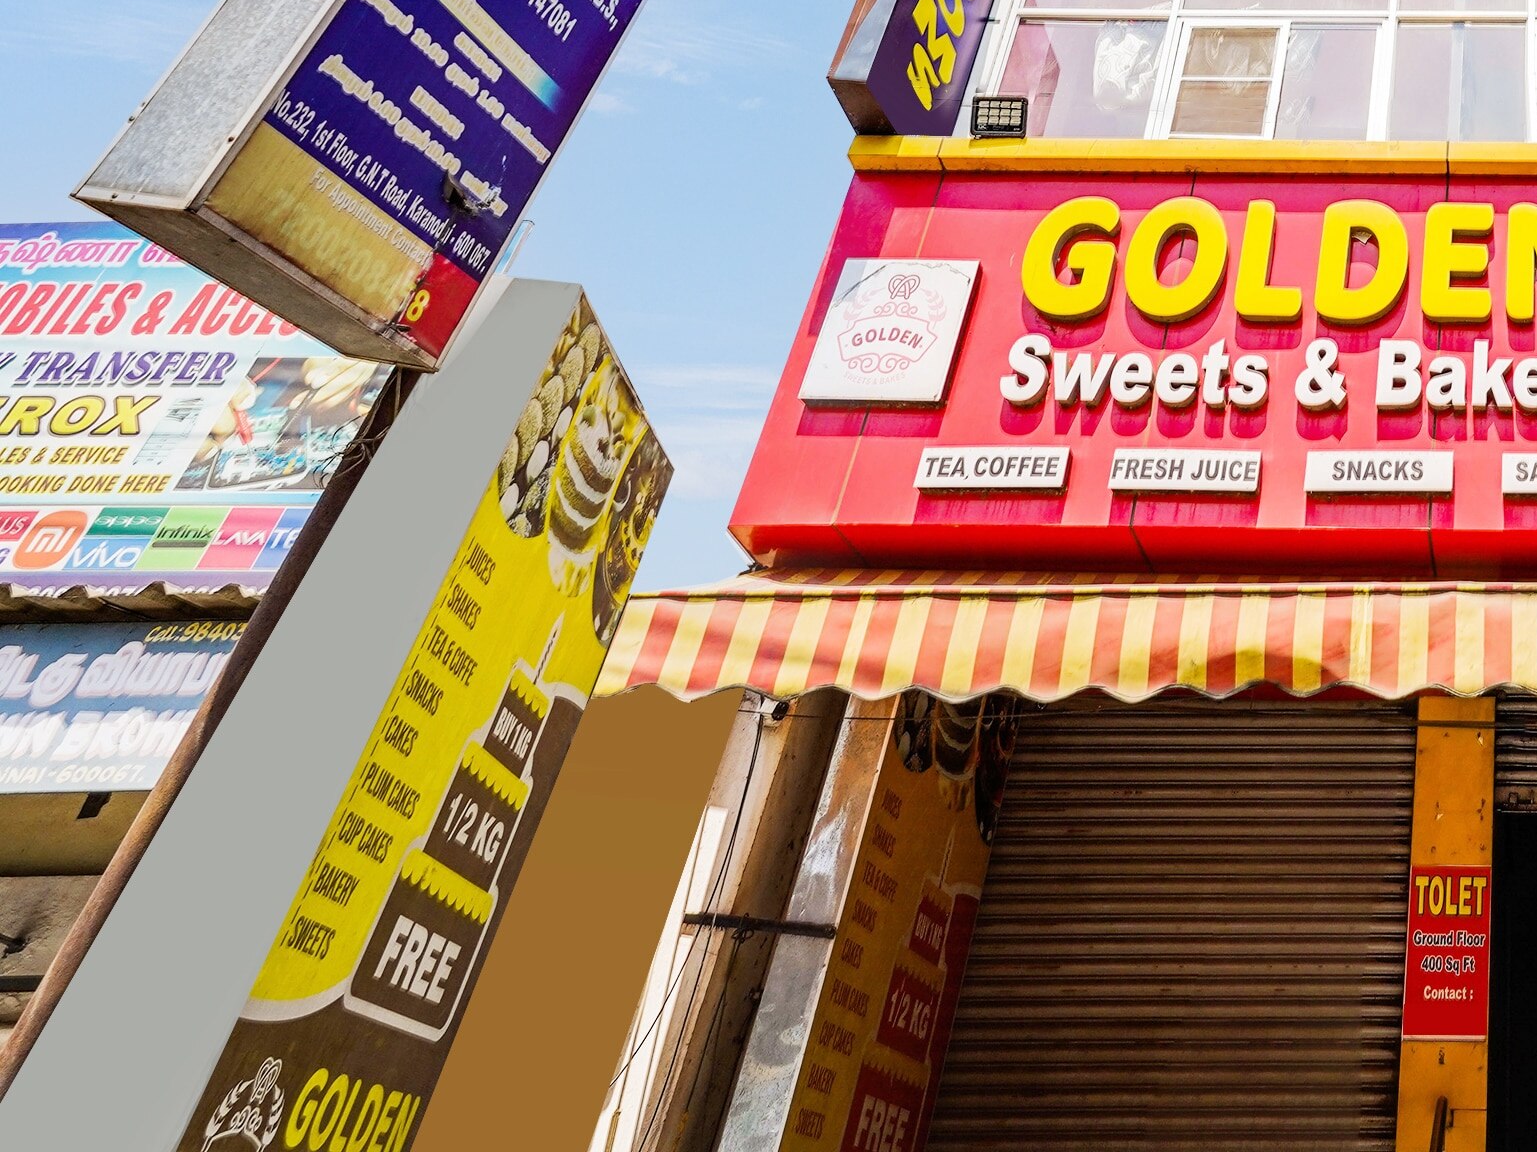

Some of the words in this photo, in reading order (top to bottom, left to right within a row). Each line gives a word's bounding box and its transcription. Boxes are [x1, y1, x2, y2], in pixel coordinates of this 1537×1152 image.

[311, 120, 335, 156] 1st
[329, 132, 360, 177] Floor,
[355, 154, 390, 192] G.N.T
[381, 173, 411, 218] Road,
[406, 195, 451, 245] Karanodi
[453, 231, 475, 259] 600
[311, 167, 328, 192] For
[329, 181, 395, 241] Appointment
[0, 282, 142, 336] OBILES
[130, 291, 174, 336] &
[851, 327, 923, 349] GOLDEN
[16, 351, 237, 384] TRANSFER
[999, 333, 1271, 410] Sweets
[1294, 338, 1347, 411] &
[0, 395, 162, 436] ROX
[29, 446, 47, 466] &
[48, 446, 129, 466] SERVICE
[1111, 458, 1185, 481] FRESH
[1190, 459, 1257, 482] JUICE
[1331, 460, 1425, 482] SNACKS
[64, 475, 116, 494] DONE
[117, 474, 172, 495] HERE
[156, 523, 217, 540] Infinix
[211, 530, 269, 547] LAVA
[465, 542, 497, 586] JUICES
[447, 583, 482, 631] SHAKES
[426, 624, 447, 661] TEA
[442, 640, 456, 666] &
[448, 646, 478, 687] COFFE
[405, 669, 444, 716] SNACKS
[384, 714, 419, 758] CAKES
[492, 706, 519, 746] BUY
[360, 761, 395, 802] PLUM
[387, 779, 421, 820] CAKES
[338, 810, 365, 847] CUP
[357, 822, 394, 864] CAKES
[443, 793, 478, 844] 1/2
[471, 812, 504, 864] KG
[313, 862, 361, 908] BAKERY
[1415, 875, 1487, 916] TOLET
[287, 914, 336, 961] SWEETS
[840, 937, 864, 969] CAKES
[1413, 930, 1454, 947] Ground
[1455, 930, 1486, 947] Floor
[373, 914, 462, 1005] FREE
[1420, 955, 1442, 973] 400
[1444, 955, 1461, 976] Sq
[1462, 955, 1476, 973] Ft
[1423, 985, 1467, 1000] Contact
[819, 1020, 836, 1048] CUP
[833, 1027, 856, 1057] CAKES
[909, 999, 931, 1040] KG
[806, 1062, 837, 1096] BAKERY
[285, 1067, 421, 1152] GOLDEN
[795, 1107, 825, 1141] SWEETS
[854, 1094, 911, 1152] FREE
